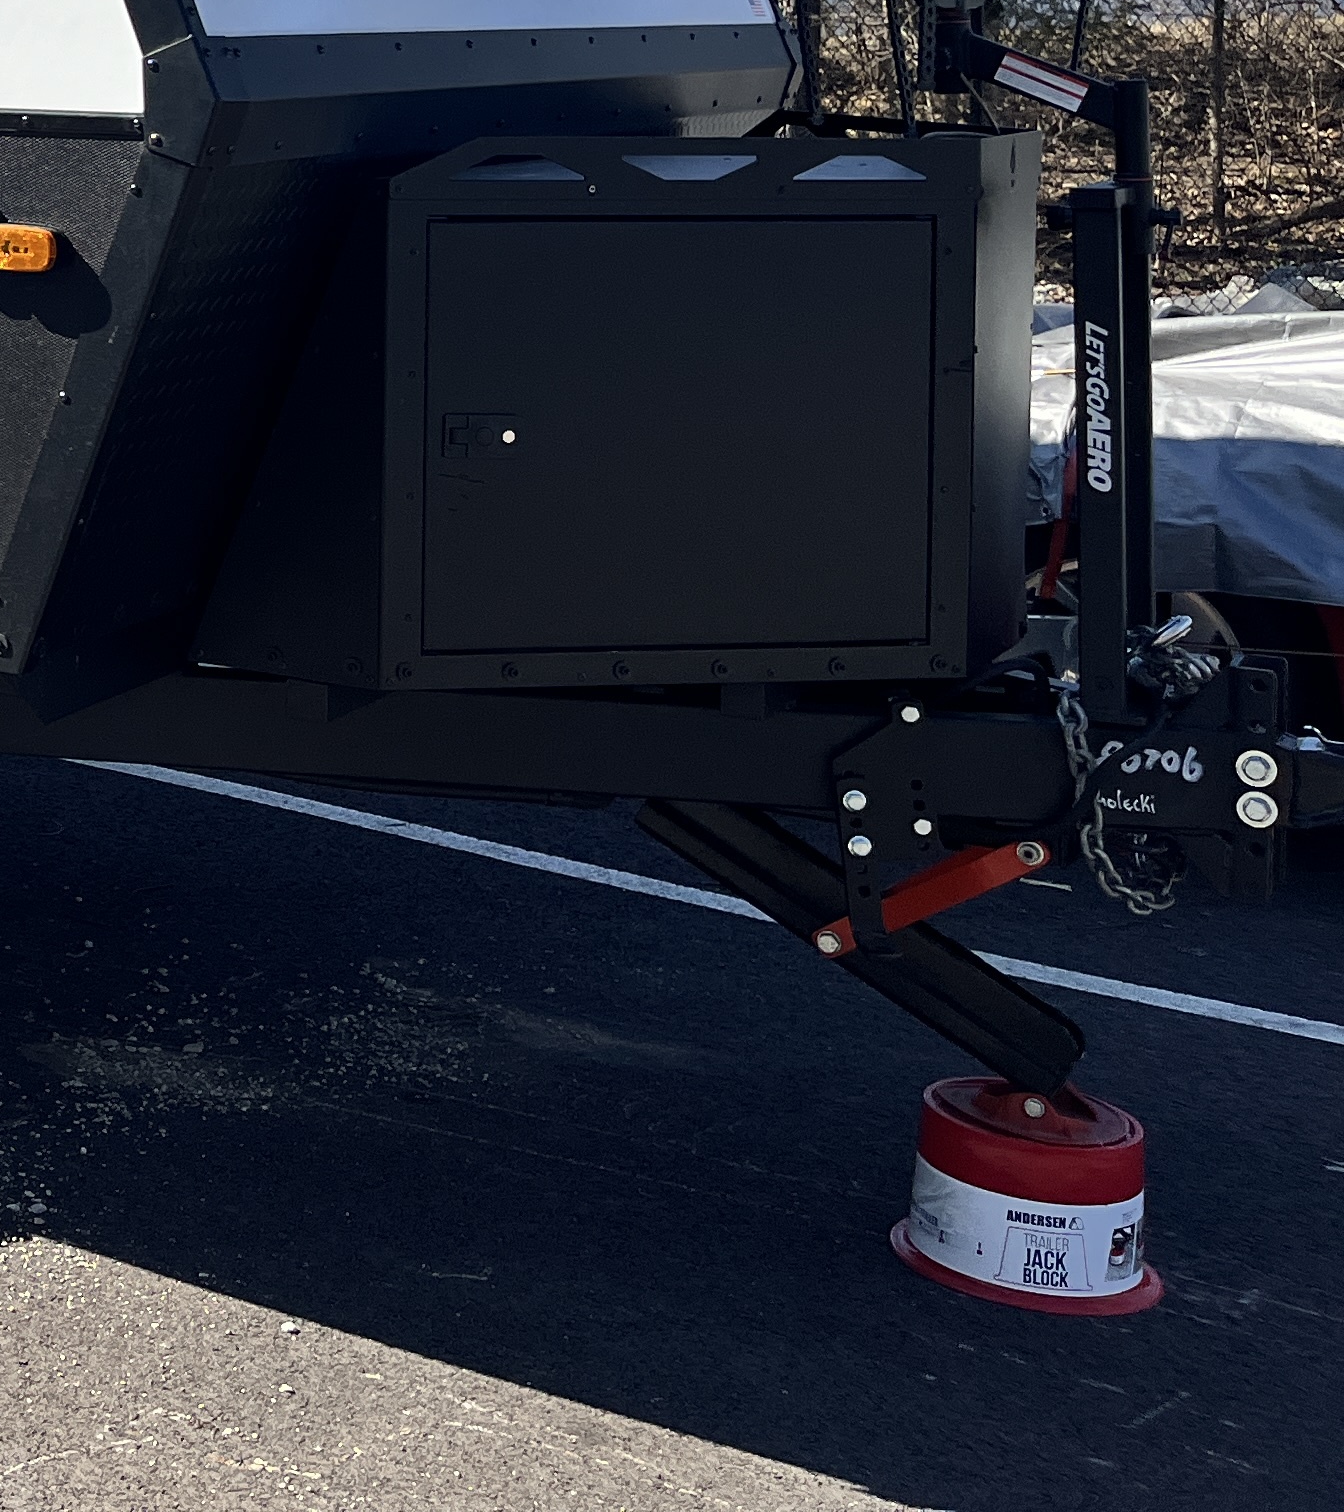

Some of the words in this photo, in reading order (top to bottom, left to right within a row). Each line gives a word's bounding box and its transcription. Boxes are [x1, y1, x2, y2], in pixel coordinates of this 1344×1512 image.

[1006, 1209, 1067, 1230] ANDERSEN
[1023, 1232, 1070, 1252] TRAILER
[1023, 1248, 1067, 1271] JACK
[1023, 1267, 1069, 1288] BLOCK
